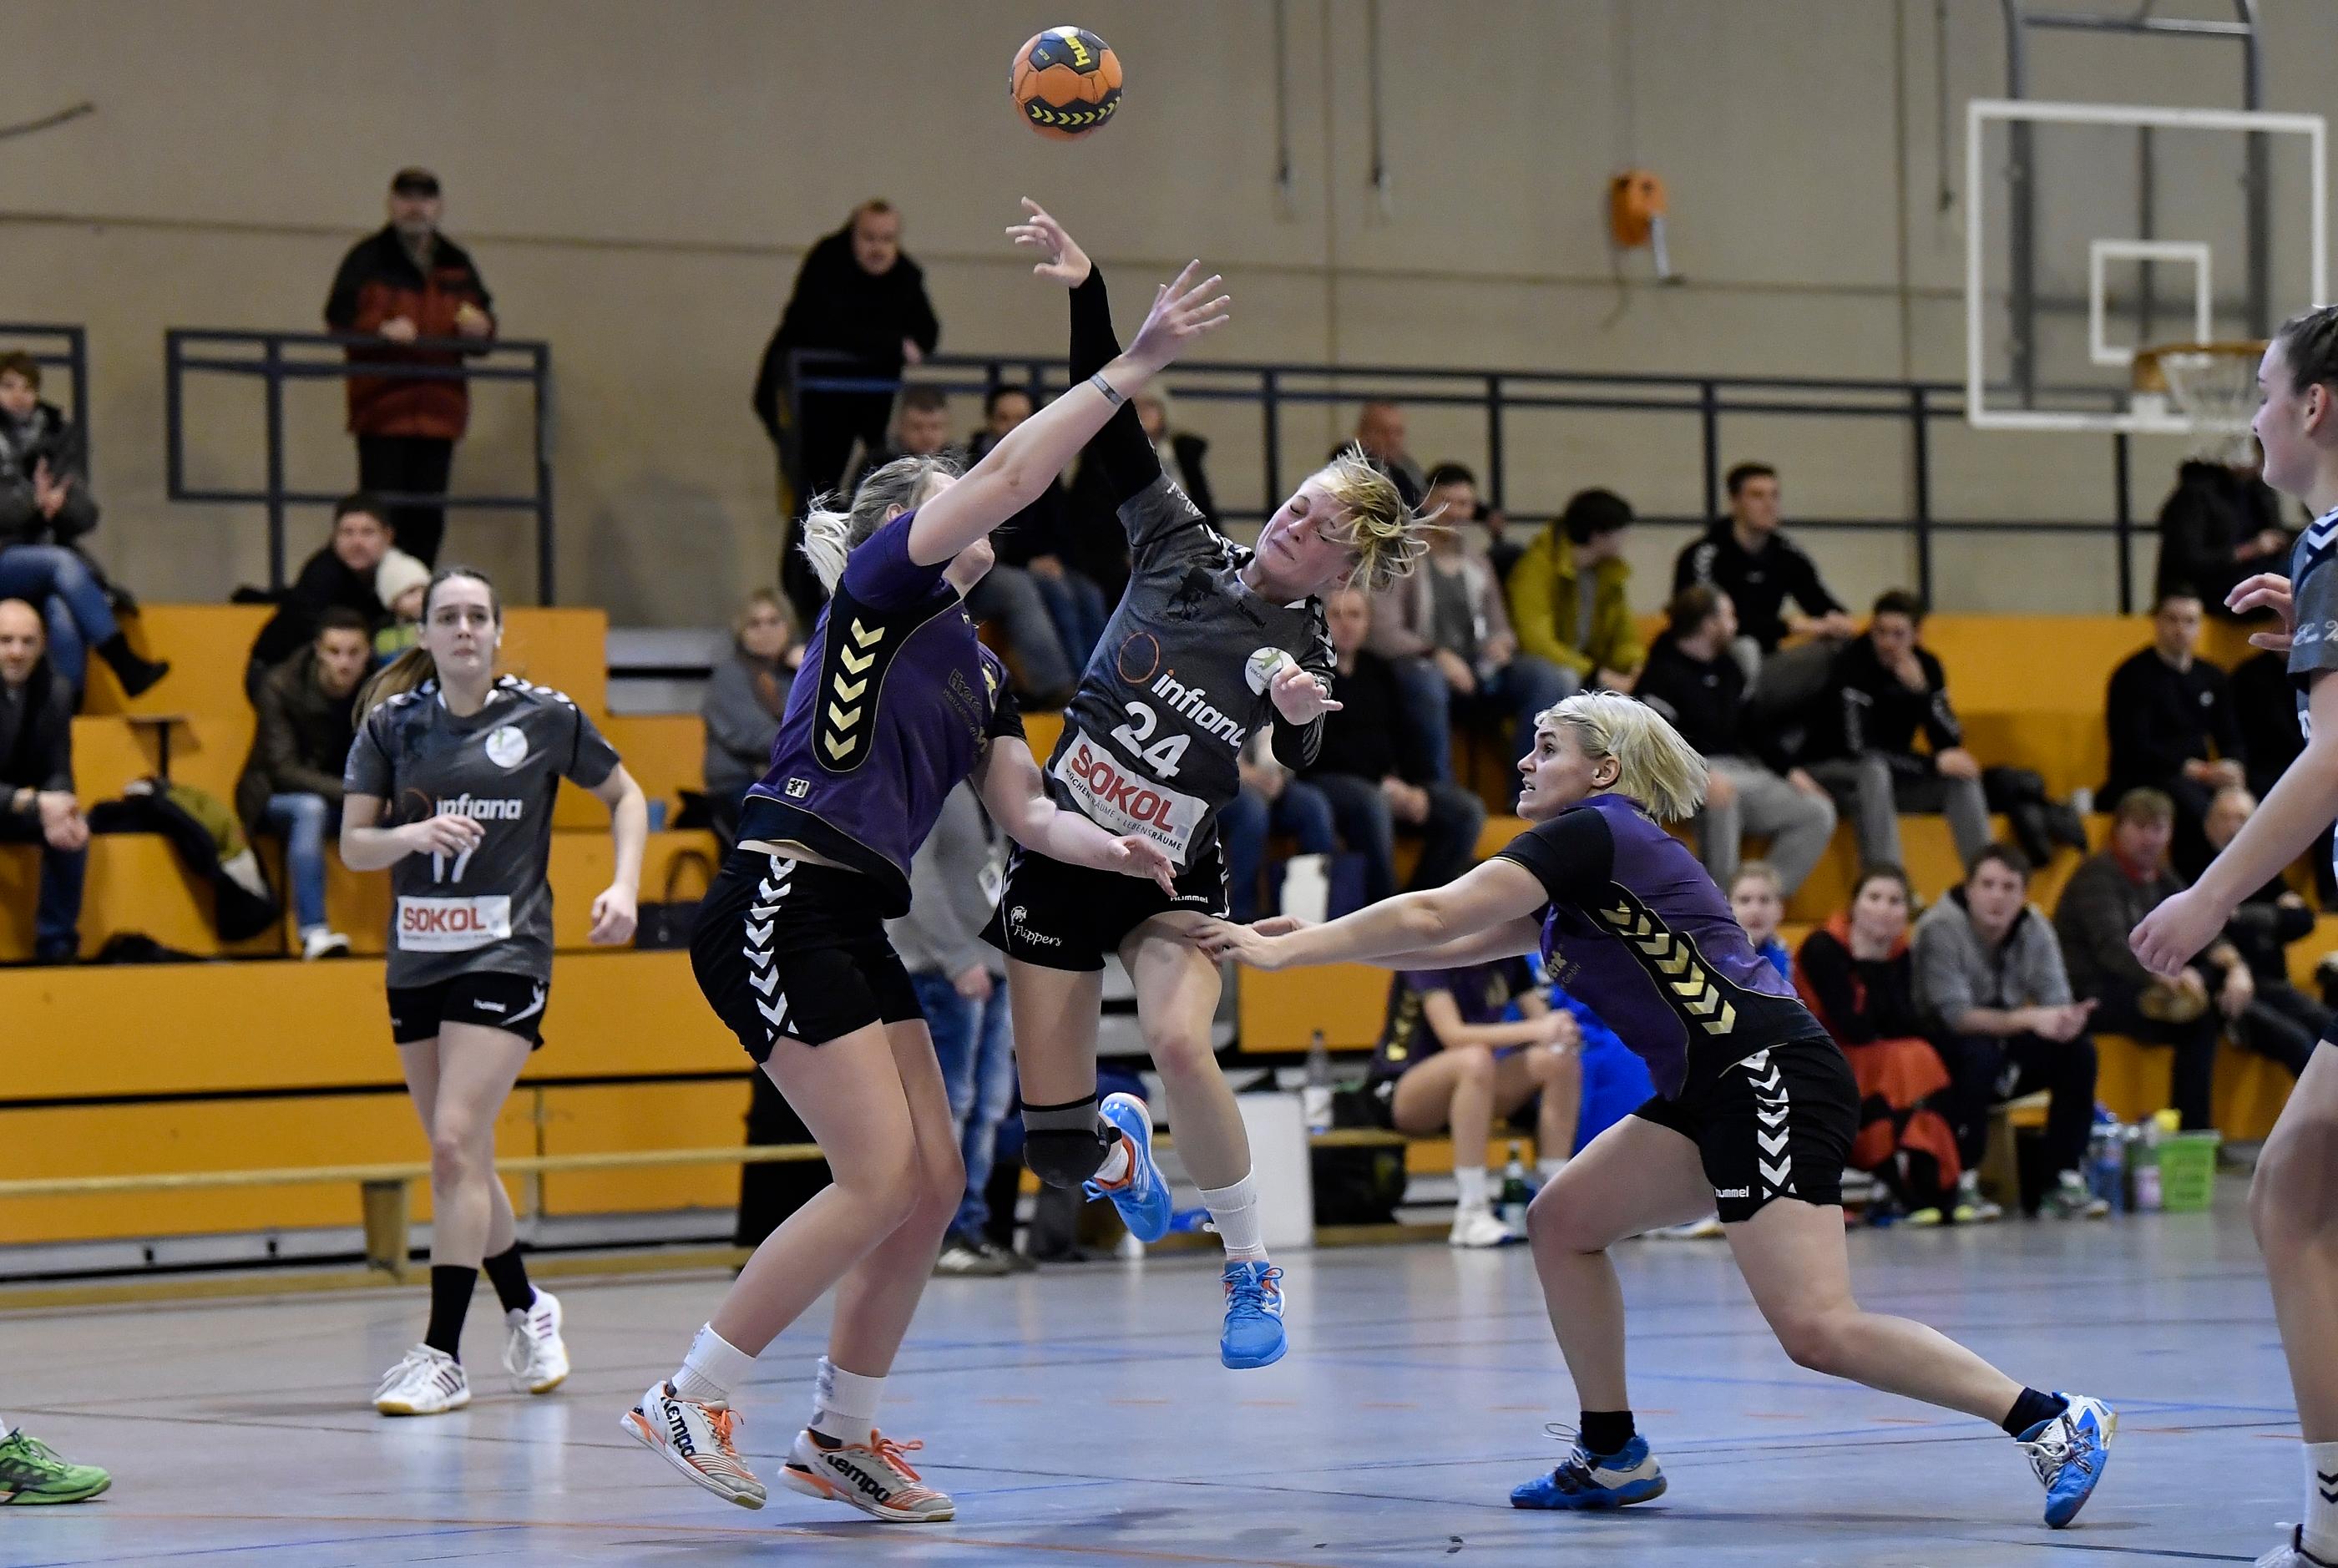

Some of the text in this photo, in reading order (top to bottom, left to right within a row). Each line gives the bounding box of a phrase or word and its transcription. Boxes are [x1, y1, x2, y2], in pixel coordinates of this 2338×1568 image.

[1111, 701, 1192, 779] 24
[1071, 744, 1174, 833] SOKOL
[1122, 819, 1183, 852] LEBENSRÄUME
[403, 906, 487, 932] SOKOL
[1014, 924, 1063, 947] Flippers
[1715, 1186, 1749, 1198] hummel
[660, 1397, 696, 1457] Kempa
[818, 1453, 891, 1502] Kempa
